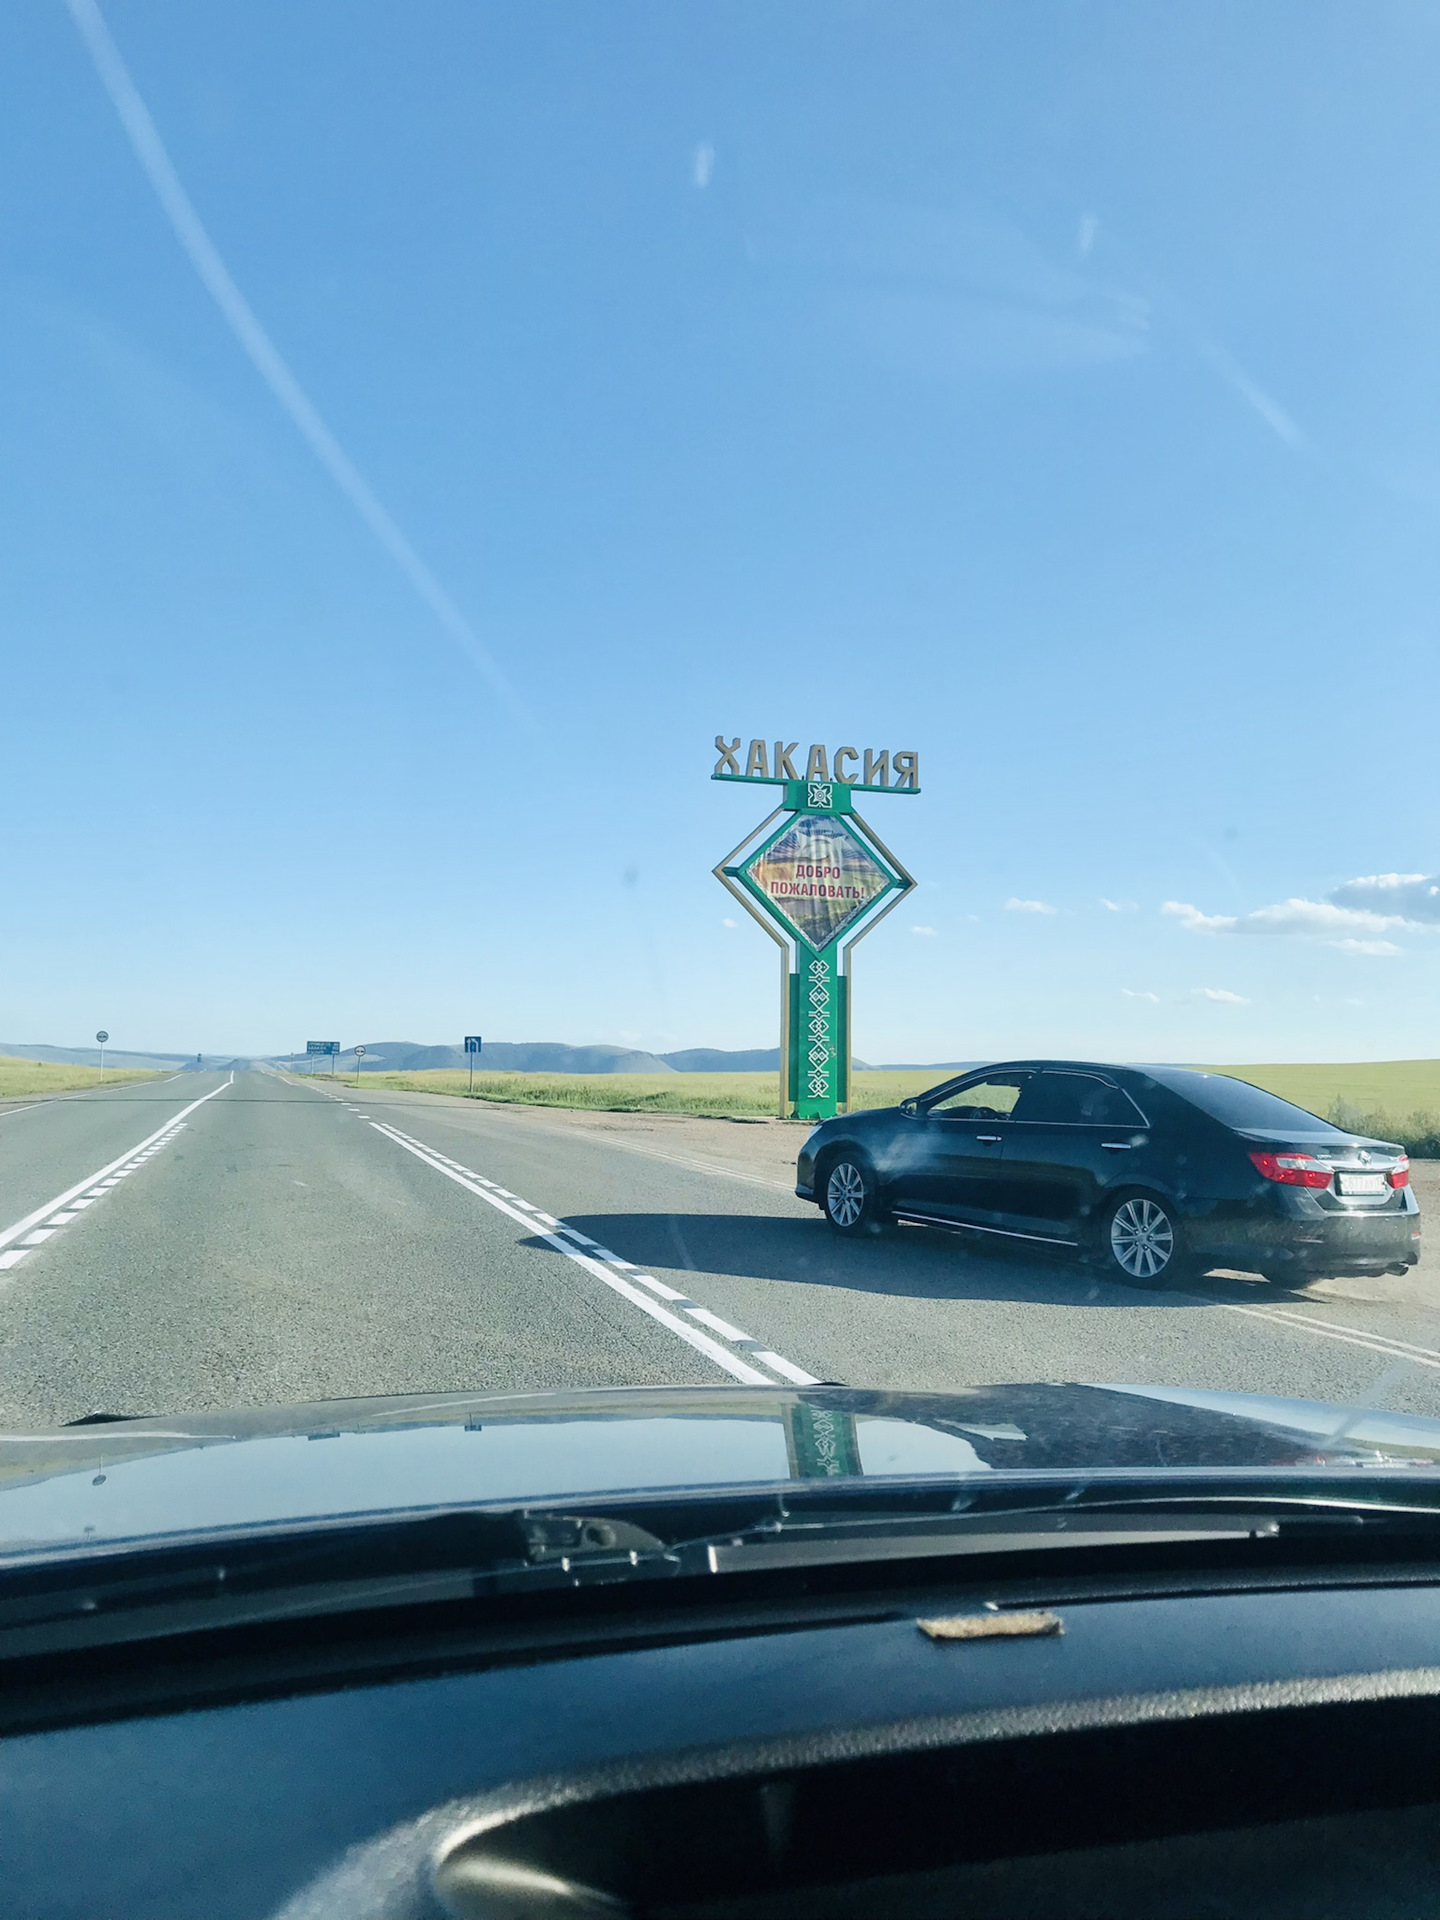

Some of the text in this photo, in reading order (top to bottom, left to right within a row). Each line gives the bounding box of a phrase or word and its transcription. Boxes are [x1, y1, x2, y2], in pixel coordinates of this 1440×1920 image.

[714, 735, 919, 788] ХАКАСИЯ
[795, 864, 841, 880] ДОБРО
[770, 881, 865, 899] ПОЖАЛОВАТЬ!
